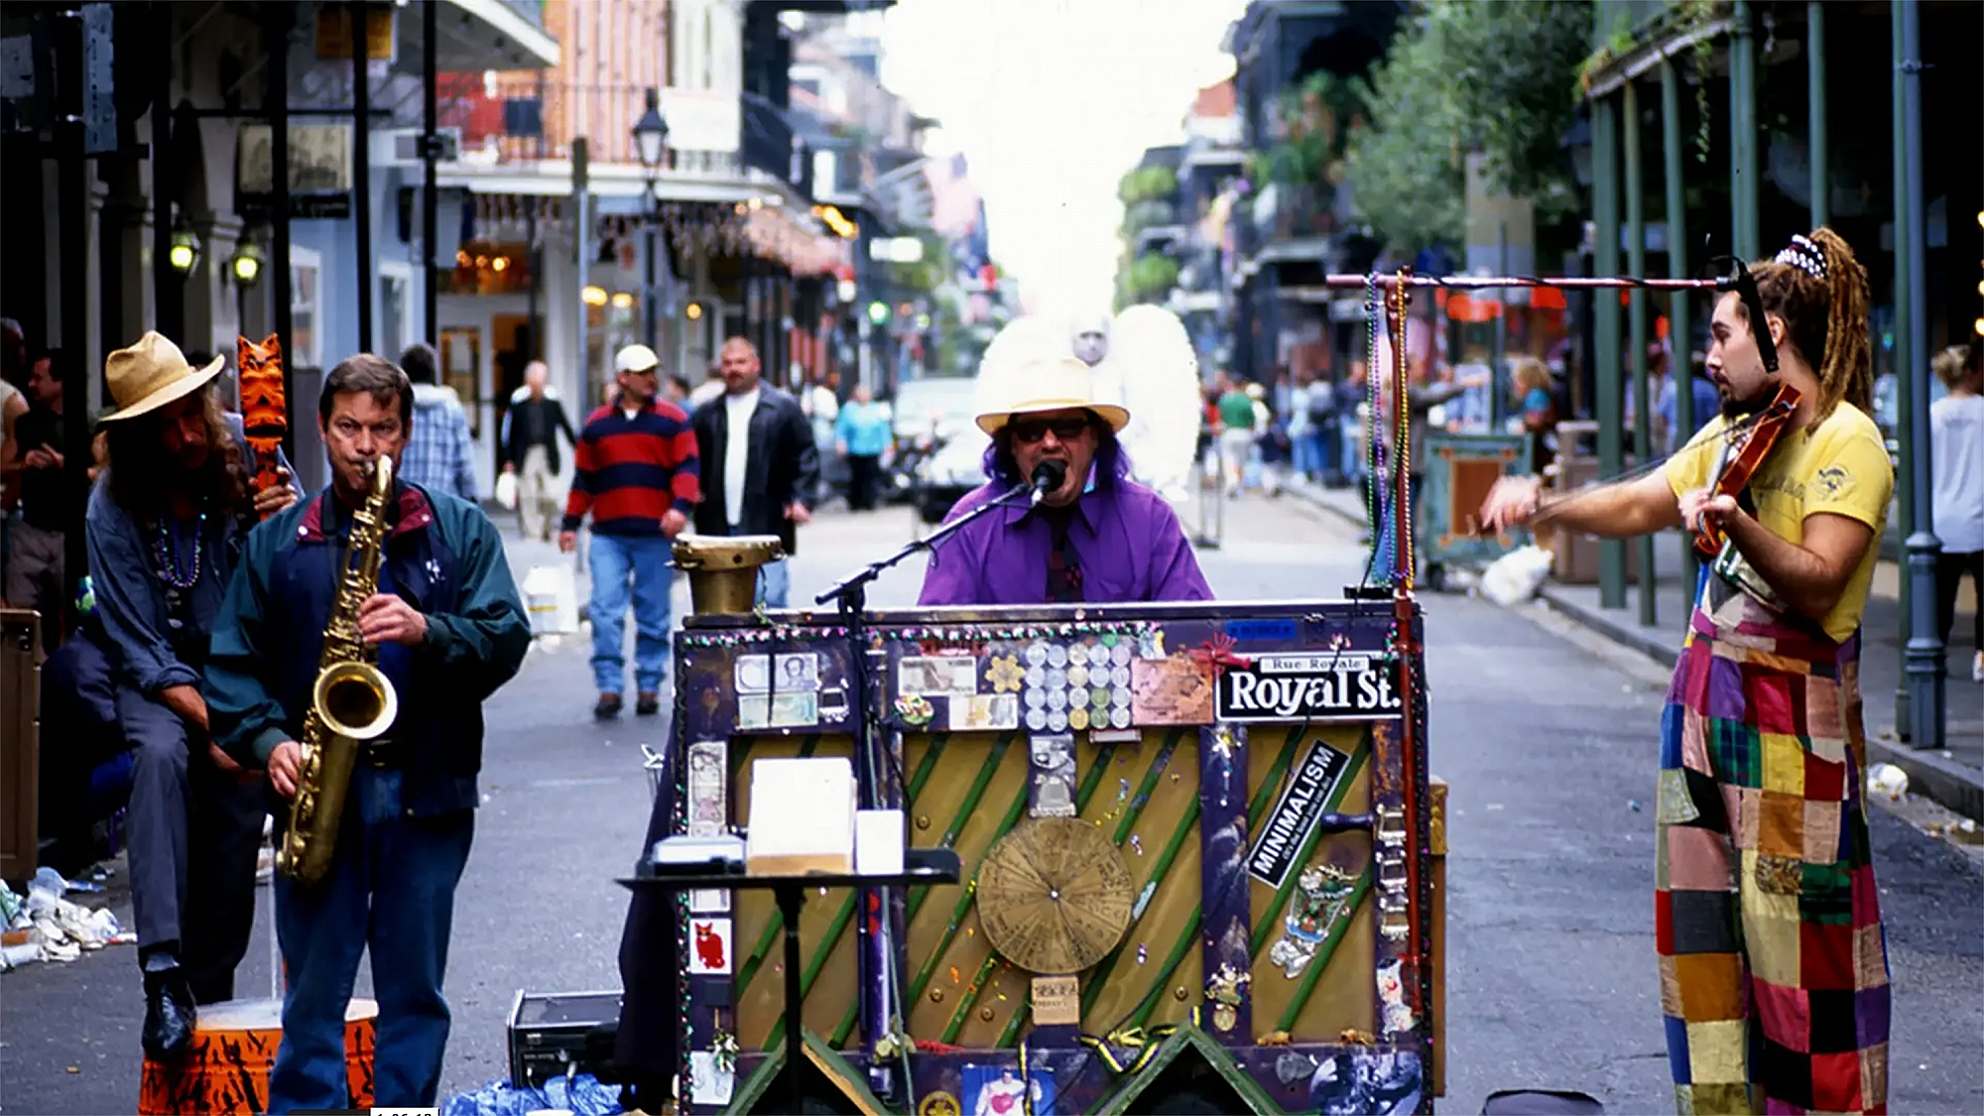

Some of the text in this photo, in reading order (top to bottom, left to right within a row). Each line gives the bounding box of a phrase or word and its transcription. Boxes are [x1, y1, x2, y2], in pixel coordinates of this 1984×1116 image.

[1273, 659, 1301, 669] Rue
[1229, 670, 1401, 715] Royal St.
[1253, 745, 1336, 875] MINIMALISM
